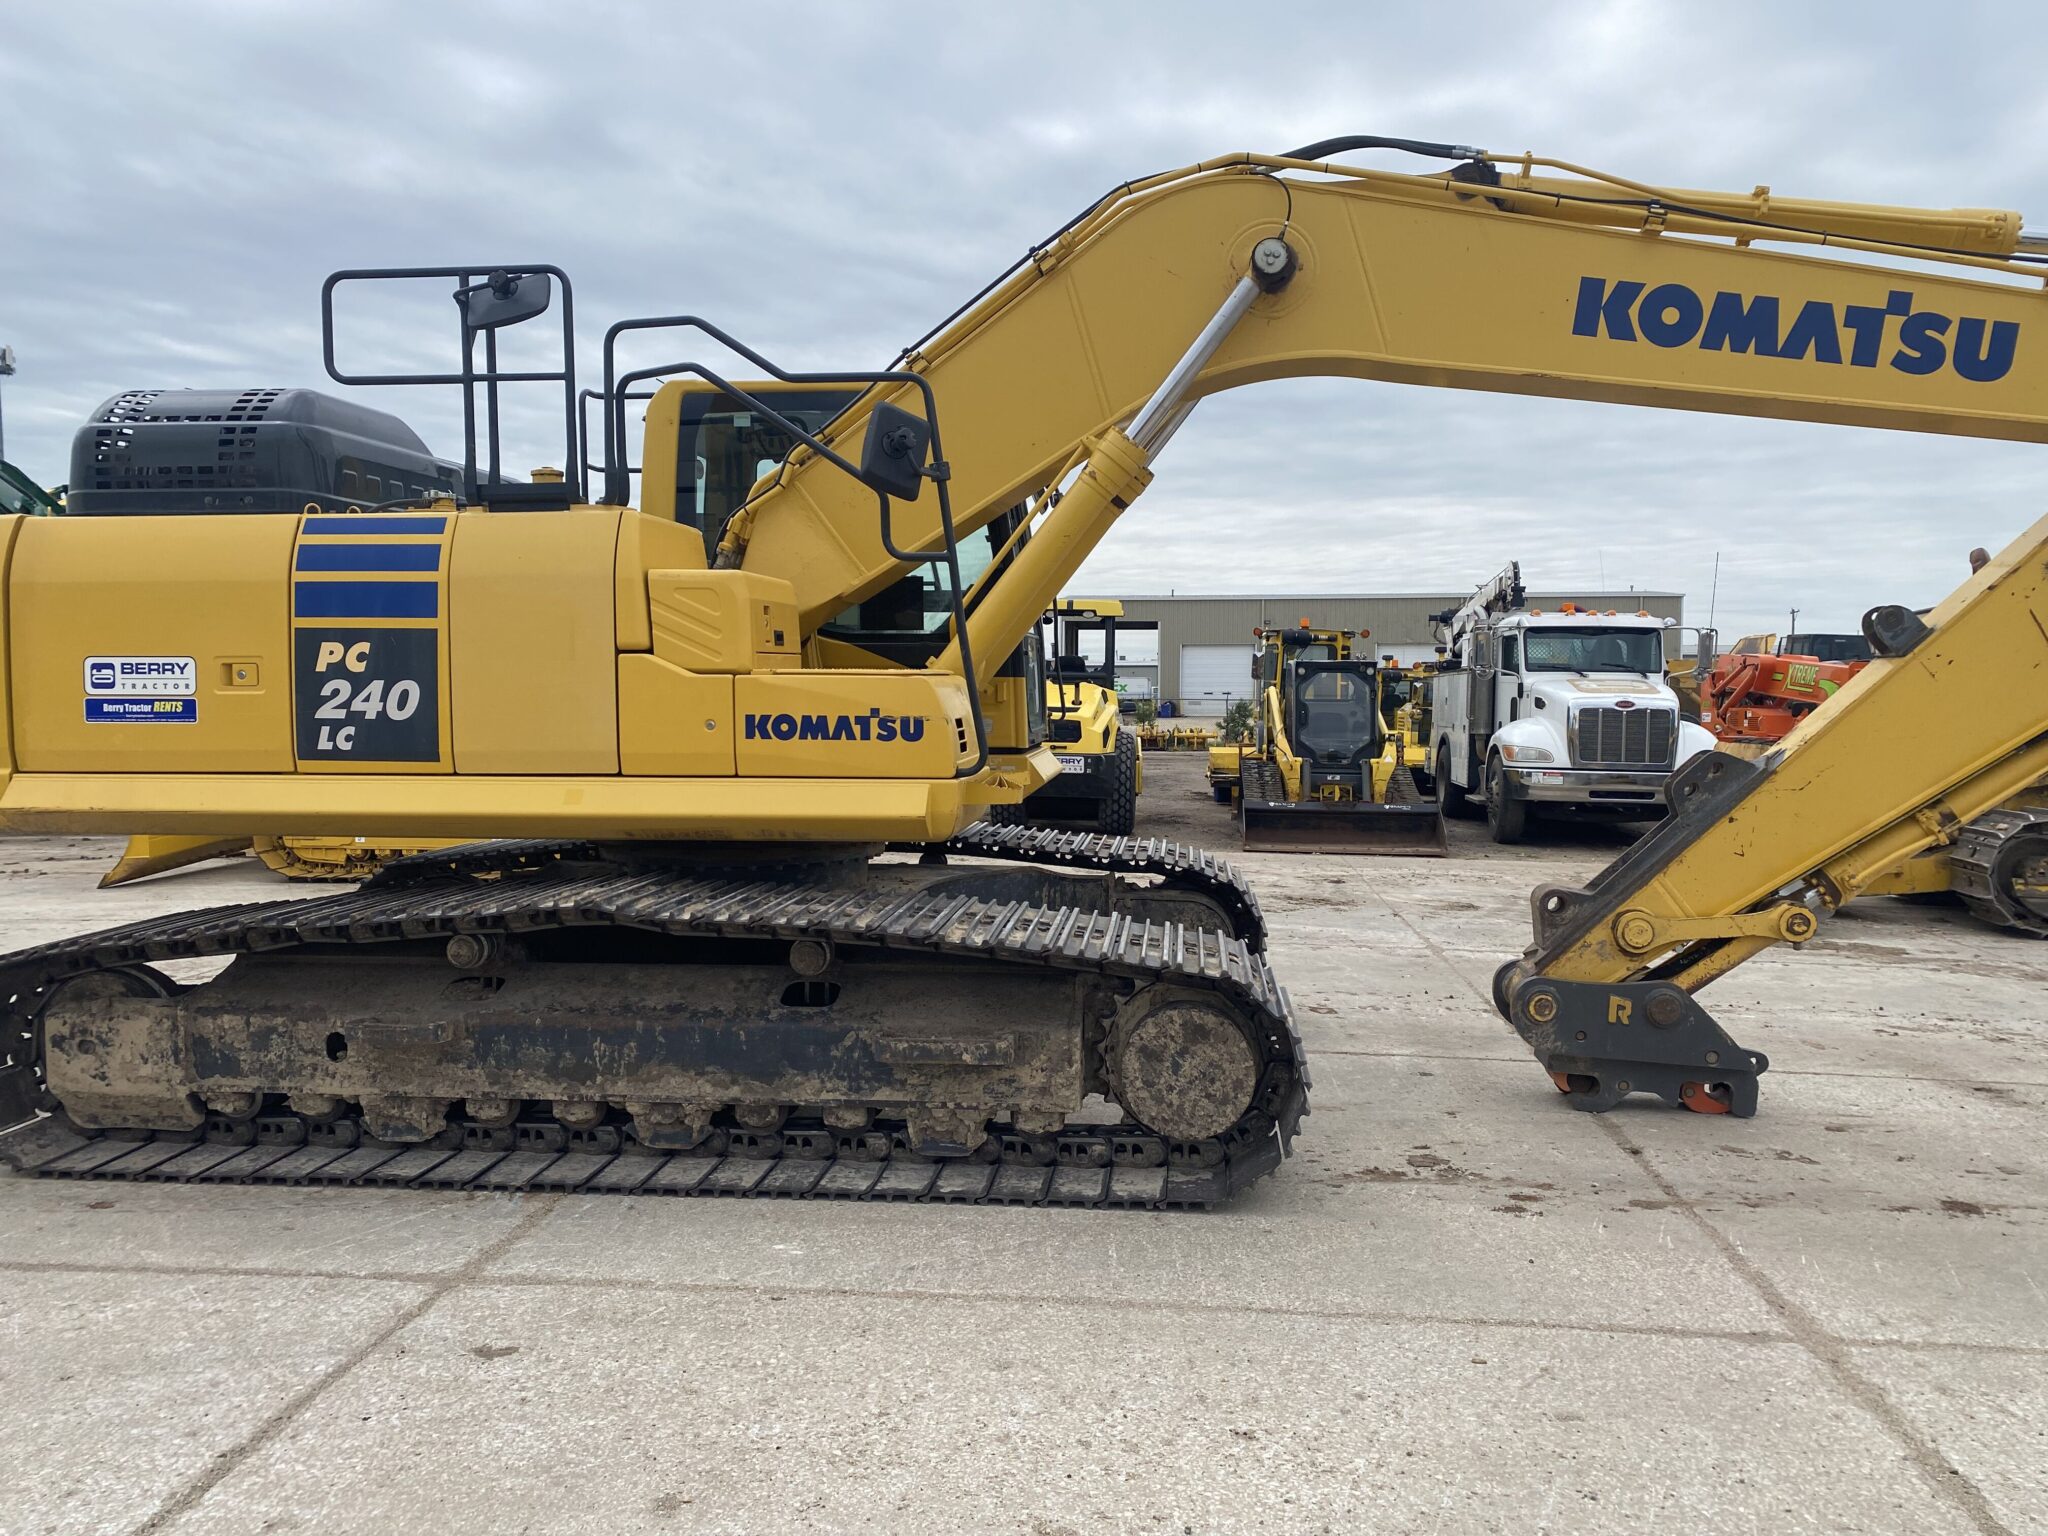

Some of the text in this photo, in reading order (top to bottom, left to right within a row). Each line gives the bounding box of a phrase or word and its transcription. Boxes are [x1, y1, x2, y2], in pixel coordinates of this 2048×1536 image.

[1572, 276, 2021, 382] KOMATSU
[120, 662, 189, 675] BERRY
[315, 641, 371, 672] PC
[121, 682, 190, 690] TRACTOR
[1782, 663, 1819, 692] XTREME
[103, 701, 183, 713] Berry Tractor RENTS
[314, 679, 421, 721] 240
[316, 725, 356, 751] LC
[745, 708, 925, 742] KOMATSU
[1607, 995, 1633, 1025] R
